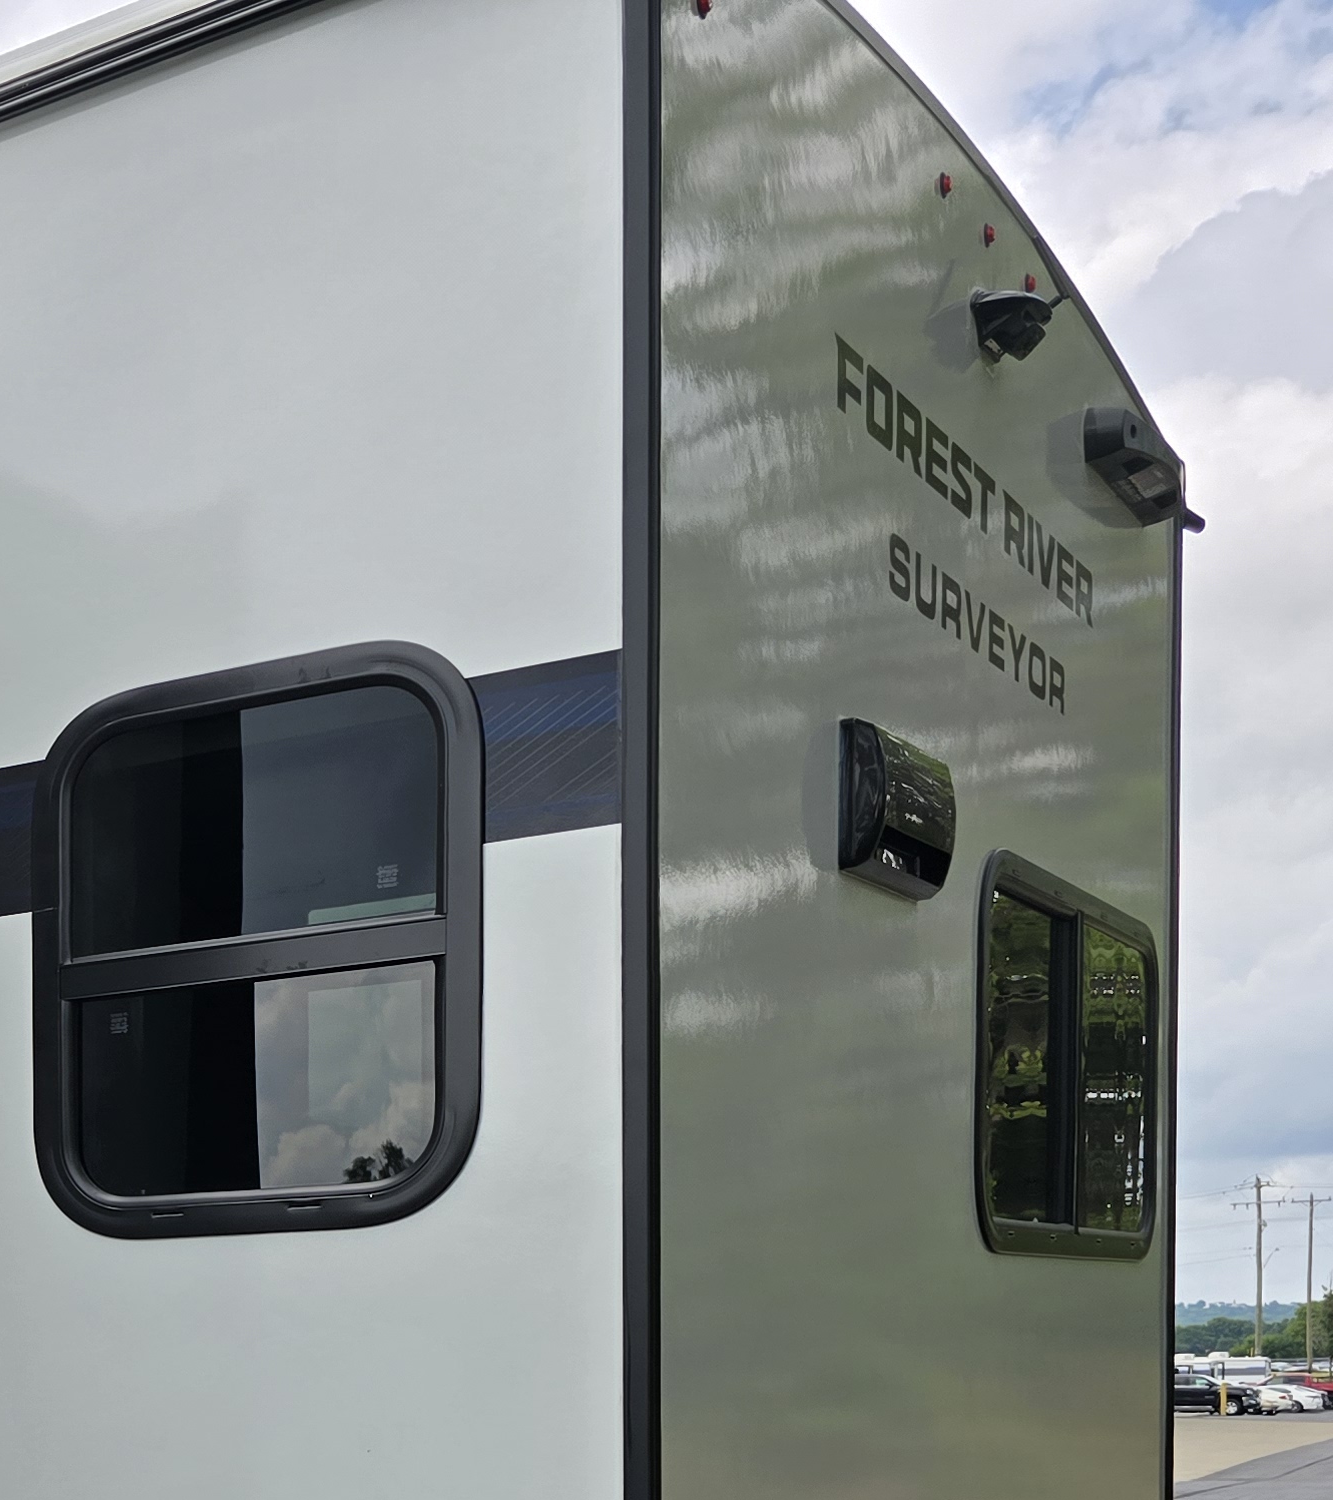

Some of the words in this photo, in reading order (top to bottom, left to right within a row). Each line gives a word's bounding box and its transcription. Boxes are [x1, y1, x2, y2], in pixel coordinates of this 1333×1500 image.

[834, 331, 996, 535] FOREST
[1003, 488, 1093, 628] RIVER
[889, 532, 1065, 716] SURVEYOR
